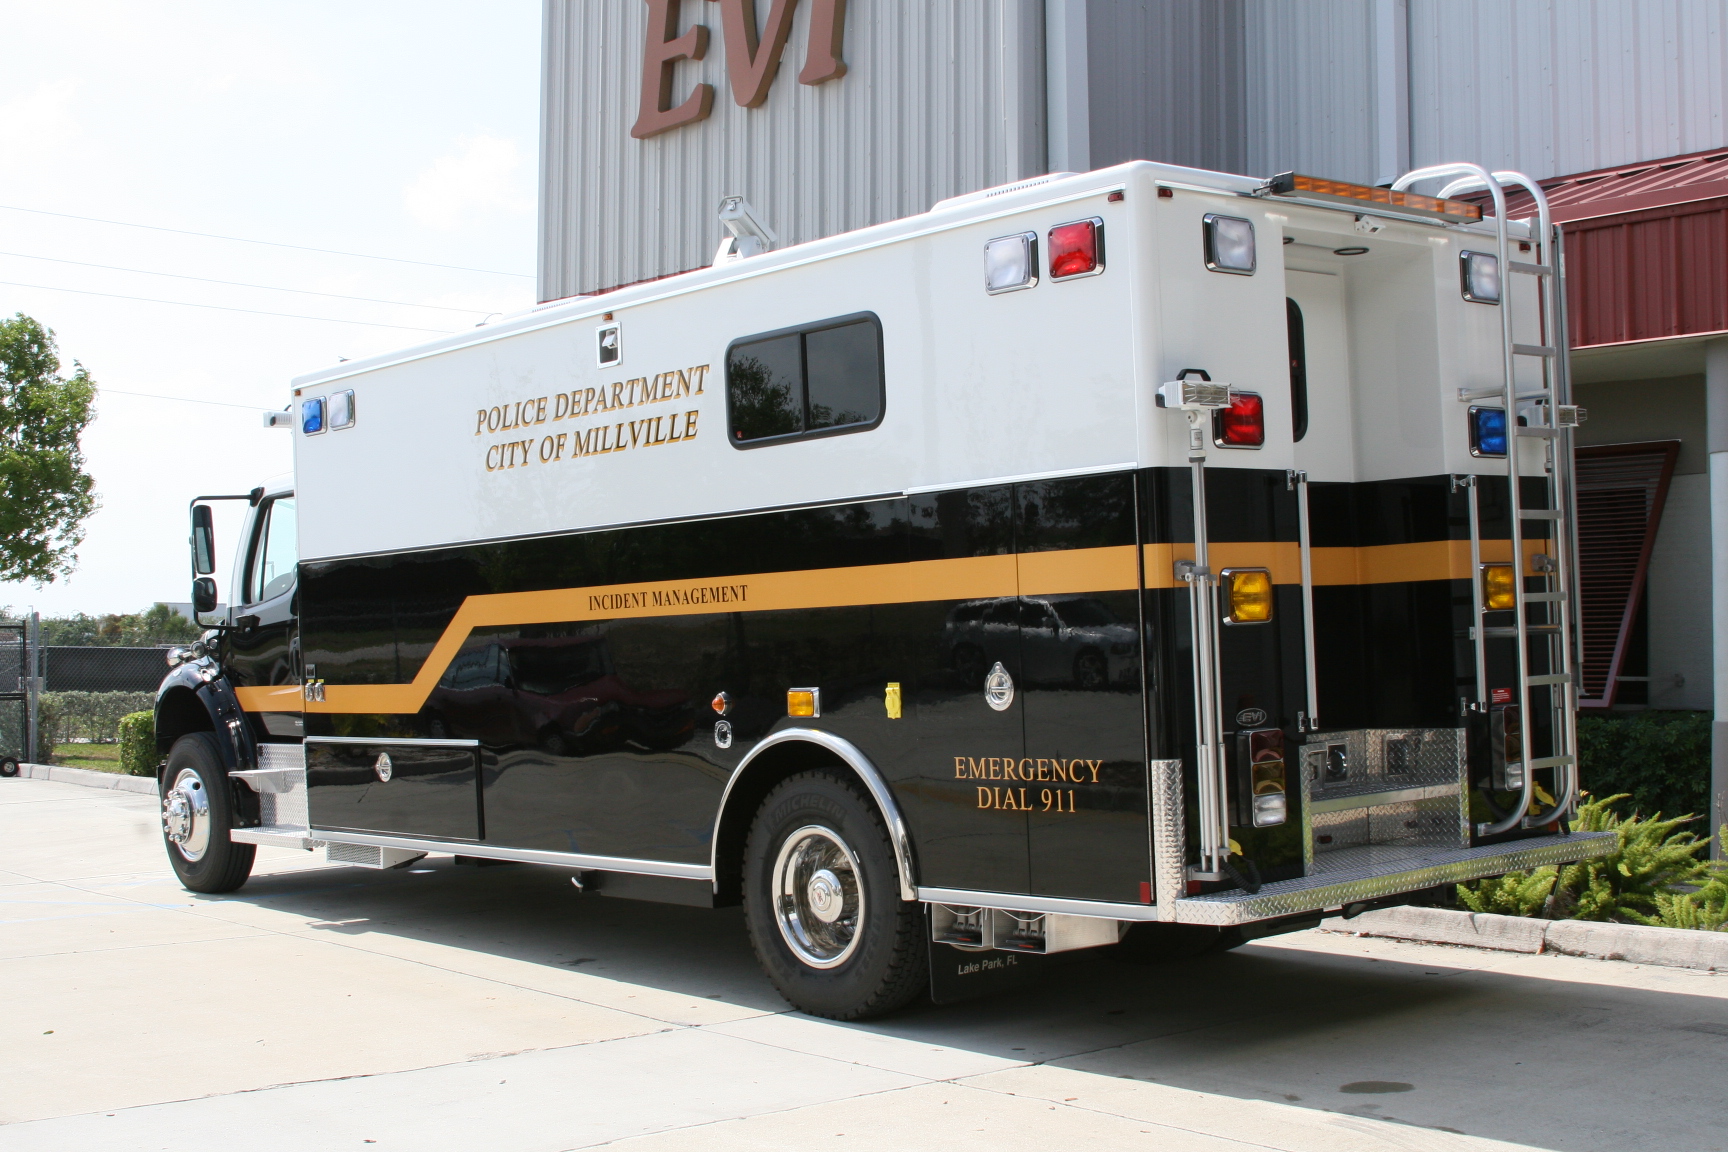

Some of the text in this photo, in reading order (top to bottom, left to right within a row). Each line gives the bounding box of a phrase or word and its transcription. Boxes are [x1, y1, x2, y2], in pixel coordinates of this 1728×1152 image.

[631, 0, 848, 140] EVI
[475, 364, 710, 436] POLICE DEPARTMENT
[485, 410, 699, 473] CITY OF MILLVILLE
[588, 585, 748, 611] INCIDENT MANAGEMENT
[954, 757, 1103, 783] EMERGENCY
[773, 794, 845, 823] MICHELIN
[976, 786, 1076, 813] DIAL 911
[957, 955, 1018, 975] Lake Park, FL
